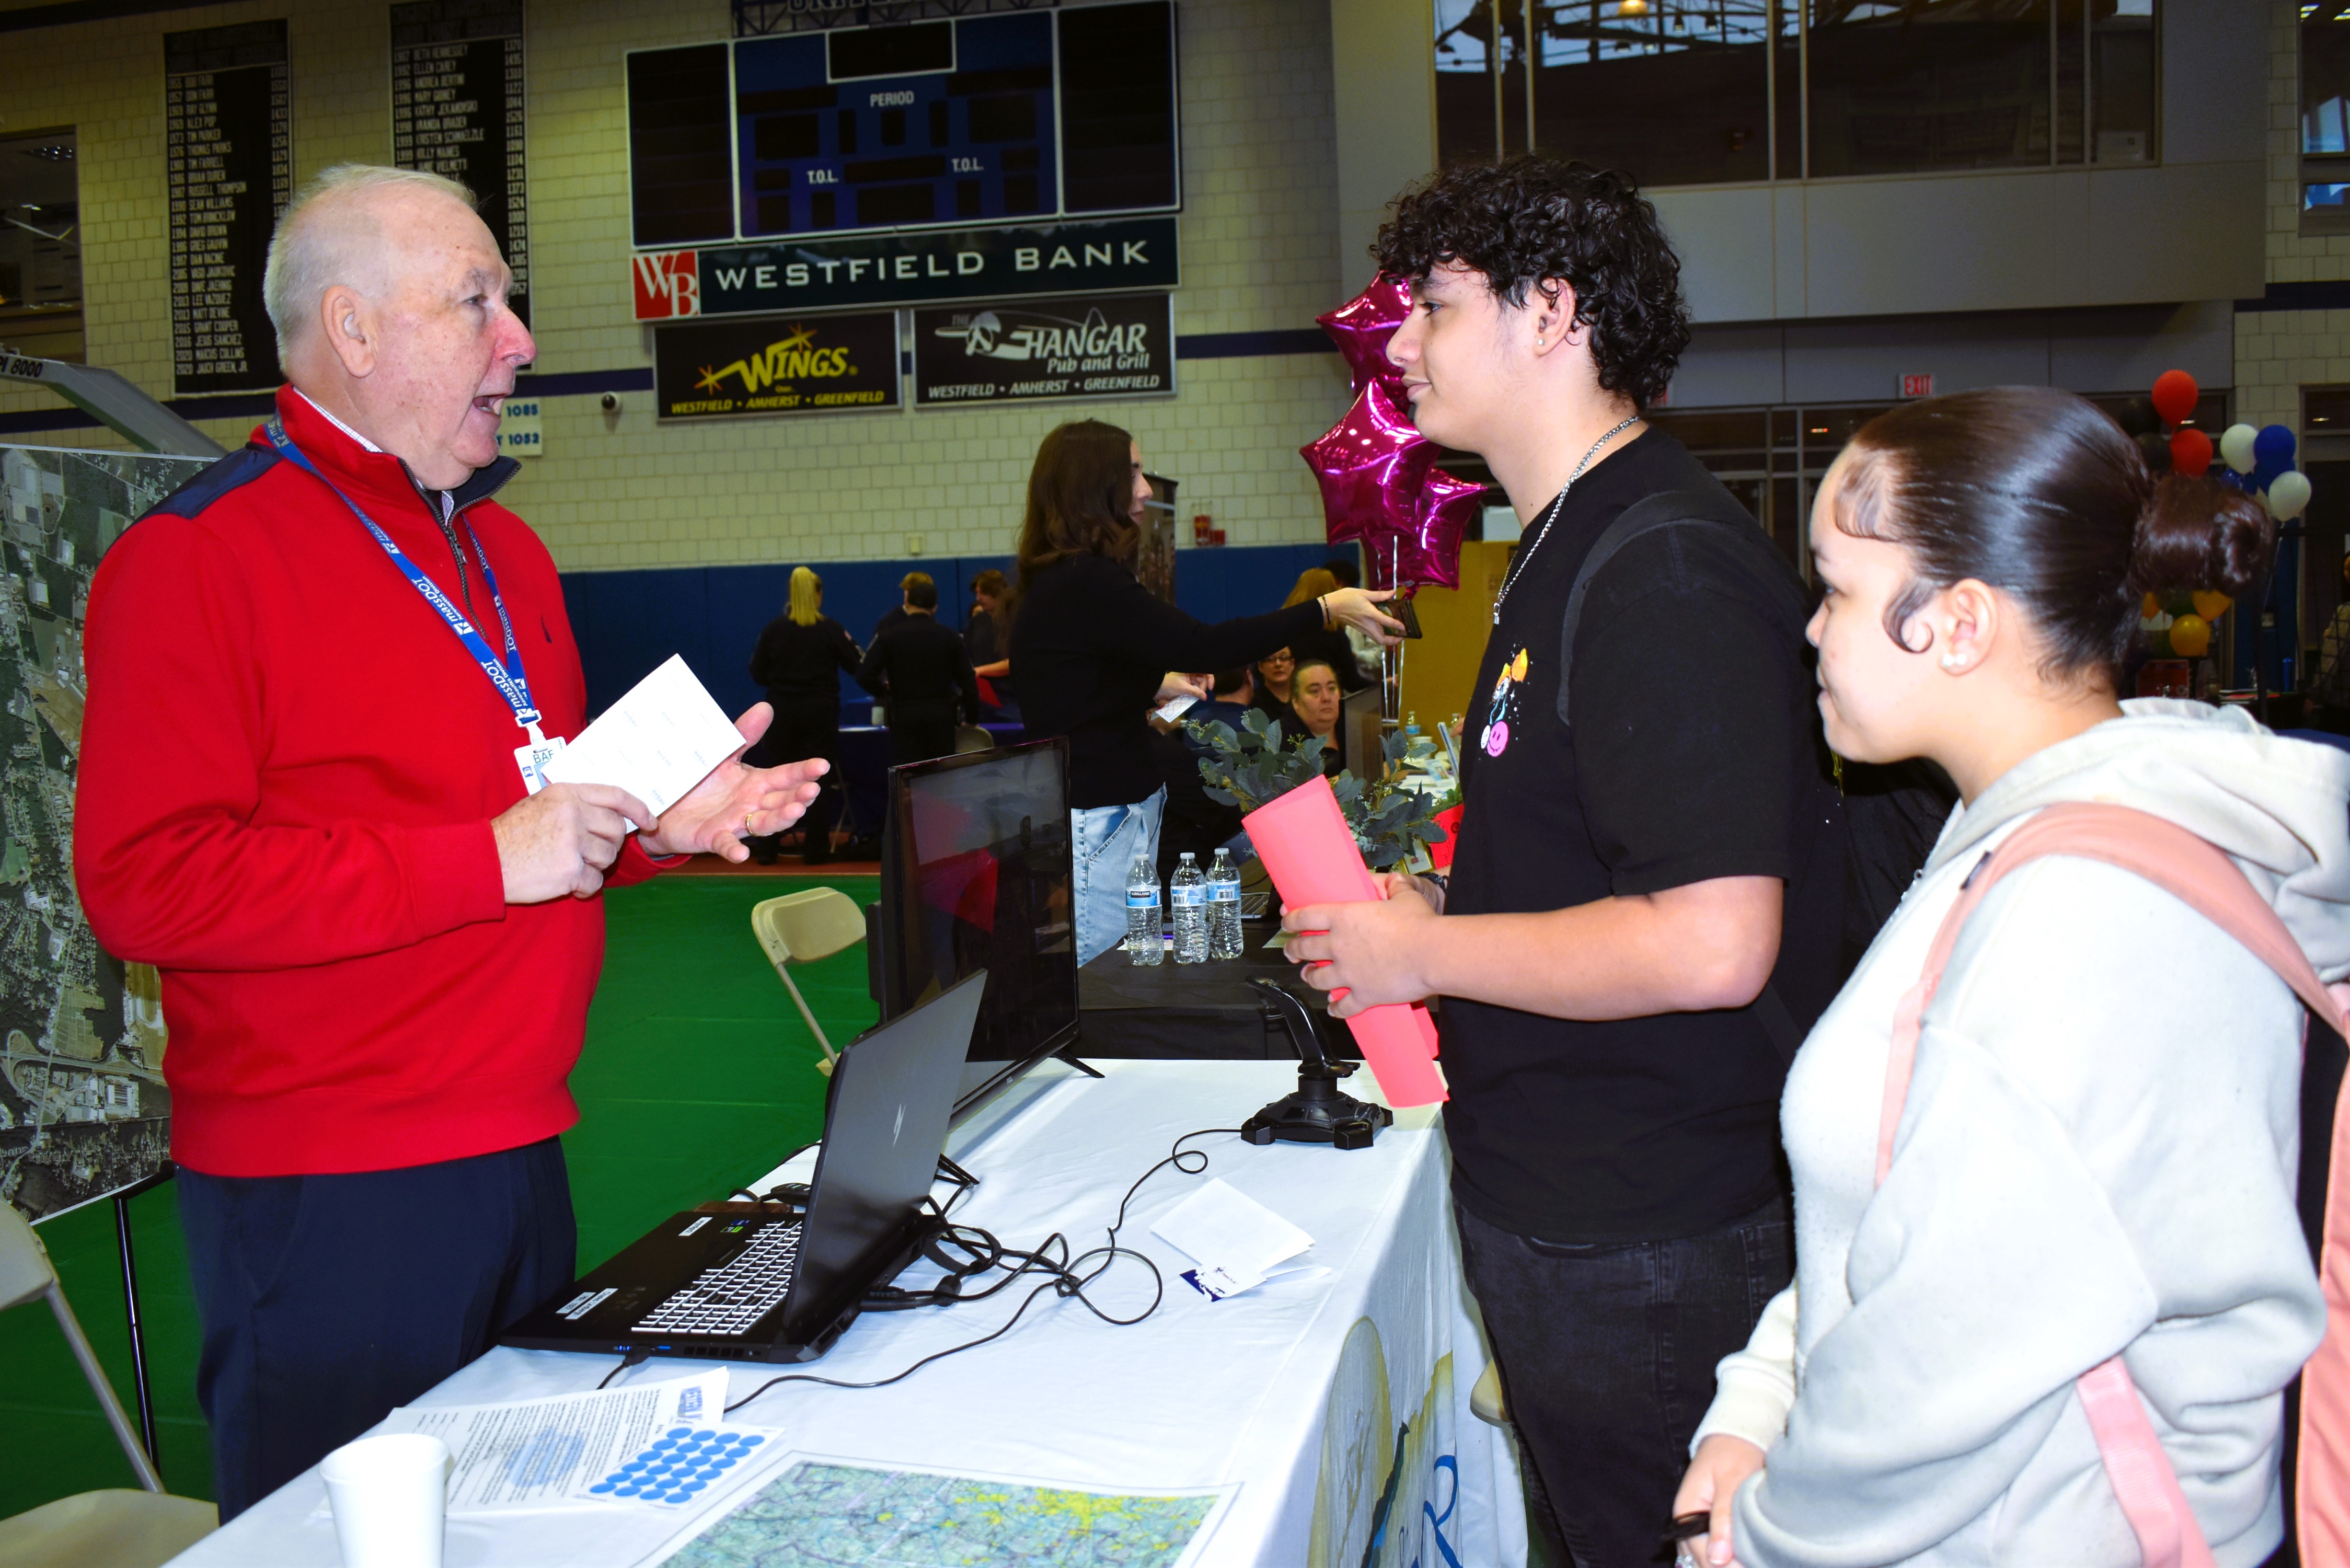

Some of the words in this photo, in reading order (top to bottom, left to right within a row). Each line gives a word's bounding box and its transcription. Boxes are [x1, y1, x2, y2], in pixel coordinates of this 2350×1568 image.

[870, 90, 915, 107] PERIOD
[187, 118, 202, 129] ALEX
[204, 116, 217, 127] POP
[951, 157, 984, 172] T.O.L.
[807, 169, 839, 185] T.O.L.
[715, 252, 983, 291] WESTFIELD
[1015, 240, 1149, 272] BANK
[634, 252, 700, 319] WB
[192, 294, 204, 306] LEE
[1027, 321, 1148, 359] HANGAR
[724, 341, 850, 394] WINGS
[1046, 357, 1076, 374] Pub
[1081, 355, 1113, 372] and
[1116, 352, 1150, 370] Grill
[928, 383, 995, 399] WESTFIELD
[1009, 379, 1070, 396] AMHERST
[1083, 375, 1160, 391] GREENFIELD
[1904, 374, 1932, 396] EXIT
[671, 399, 733, 416] WESTFIELD
[744, 394, 802, 409] AMHERST
[813, 390, 885, 406] GREENFIELD
[422, 575, 441, 594] Division
[411, 578, 459, 622] massDOT
[438, 591, 464, 621] Aeronautics
[500, 607, 517, 651] massDOT
[493, 658, 508, 678] Division
[481, 661, 522, 708] massDOT
[623, 711, 637, 727] AVERY
[652, 789, 665, 805] AVERY
